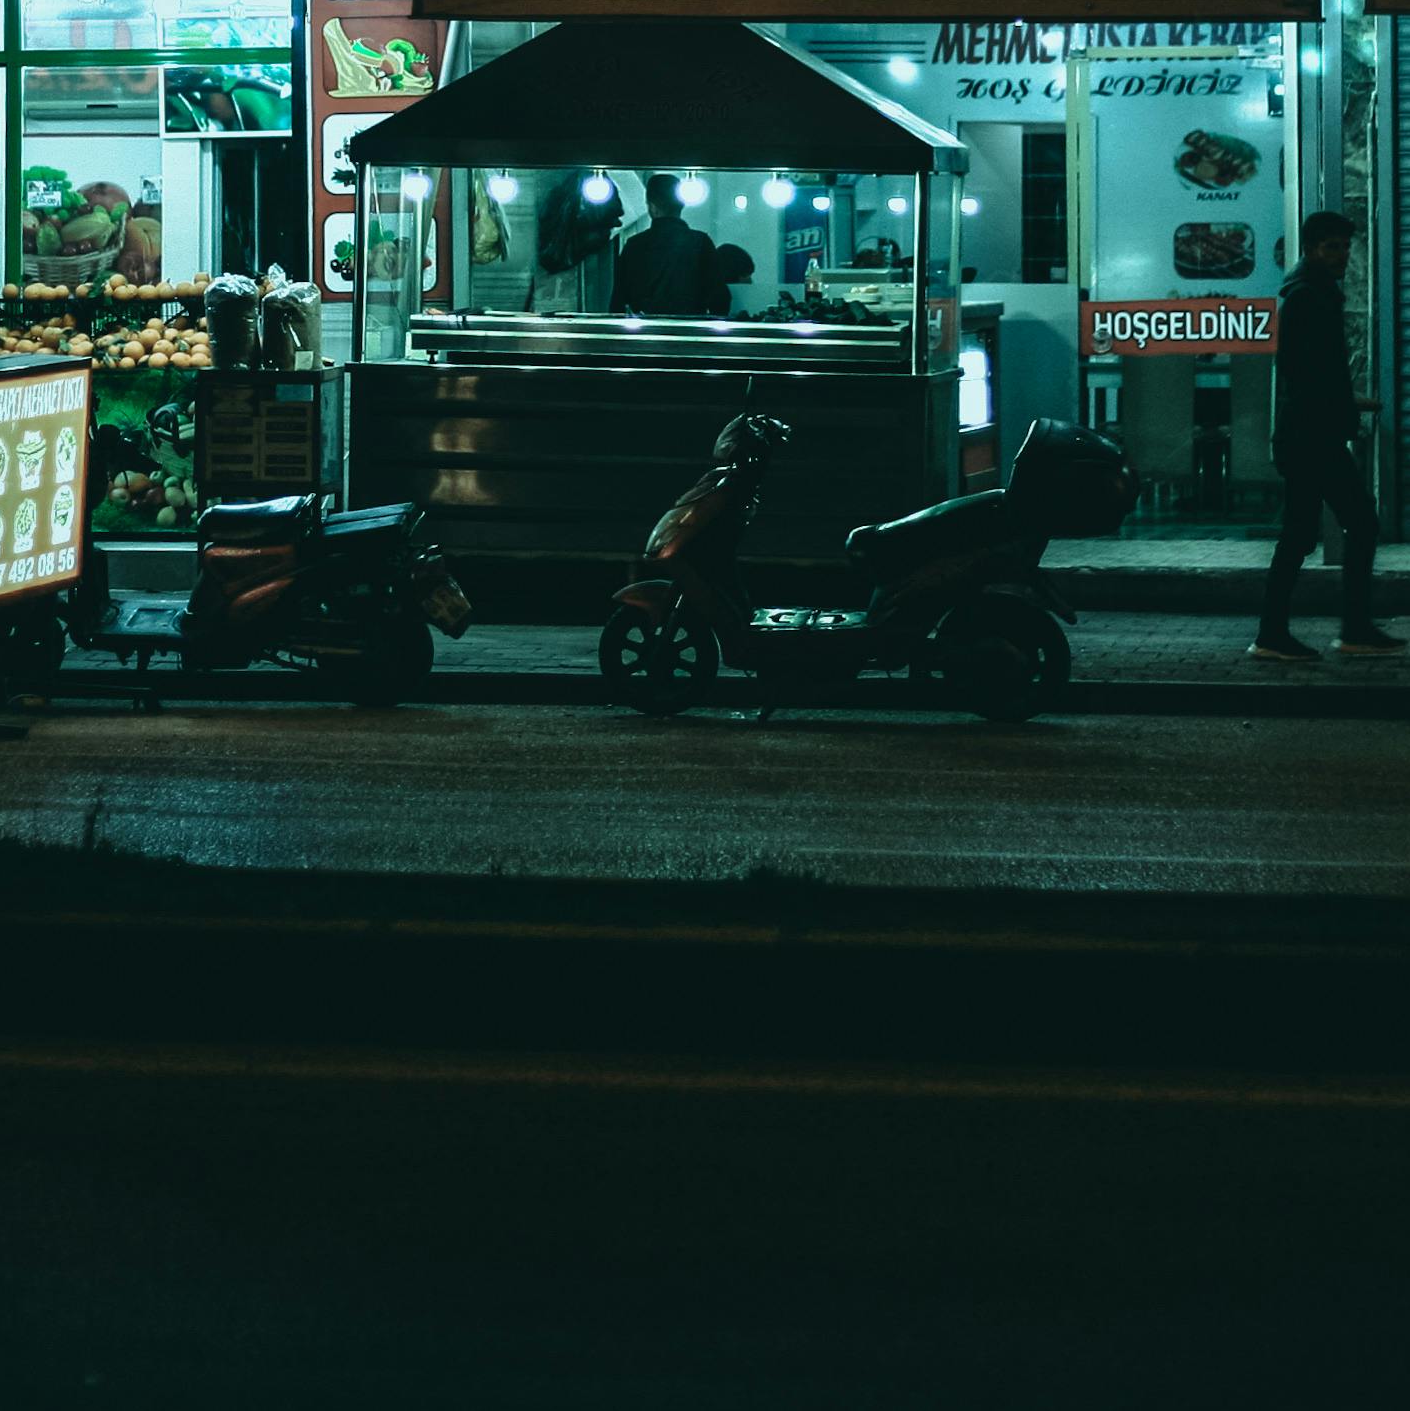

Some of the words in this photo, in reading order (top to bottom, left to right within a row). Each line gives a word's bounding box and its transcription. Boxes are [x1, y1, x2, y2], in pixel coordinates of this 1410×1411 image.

[956, 77, 1031, 105] HOŞ
[1094, 305, 1271, 349] HOŞGELDİNİZ
[8, 556, 35, 584] 492
[37, 551, 55, 578] 08
[58, 547, 75, 573] 56
